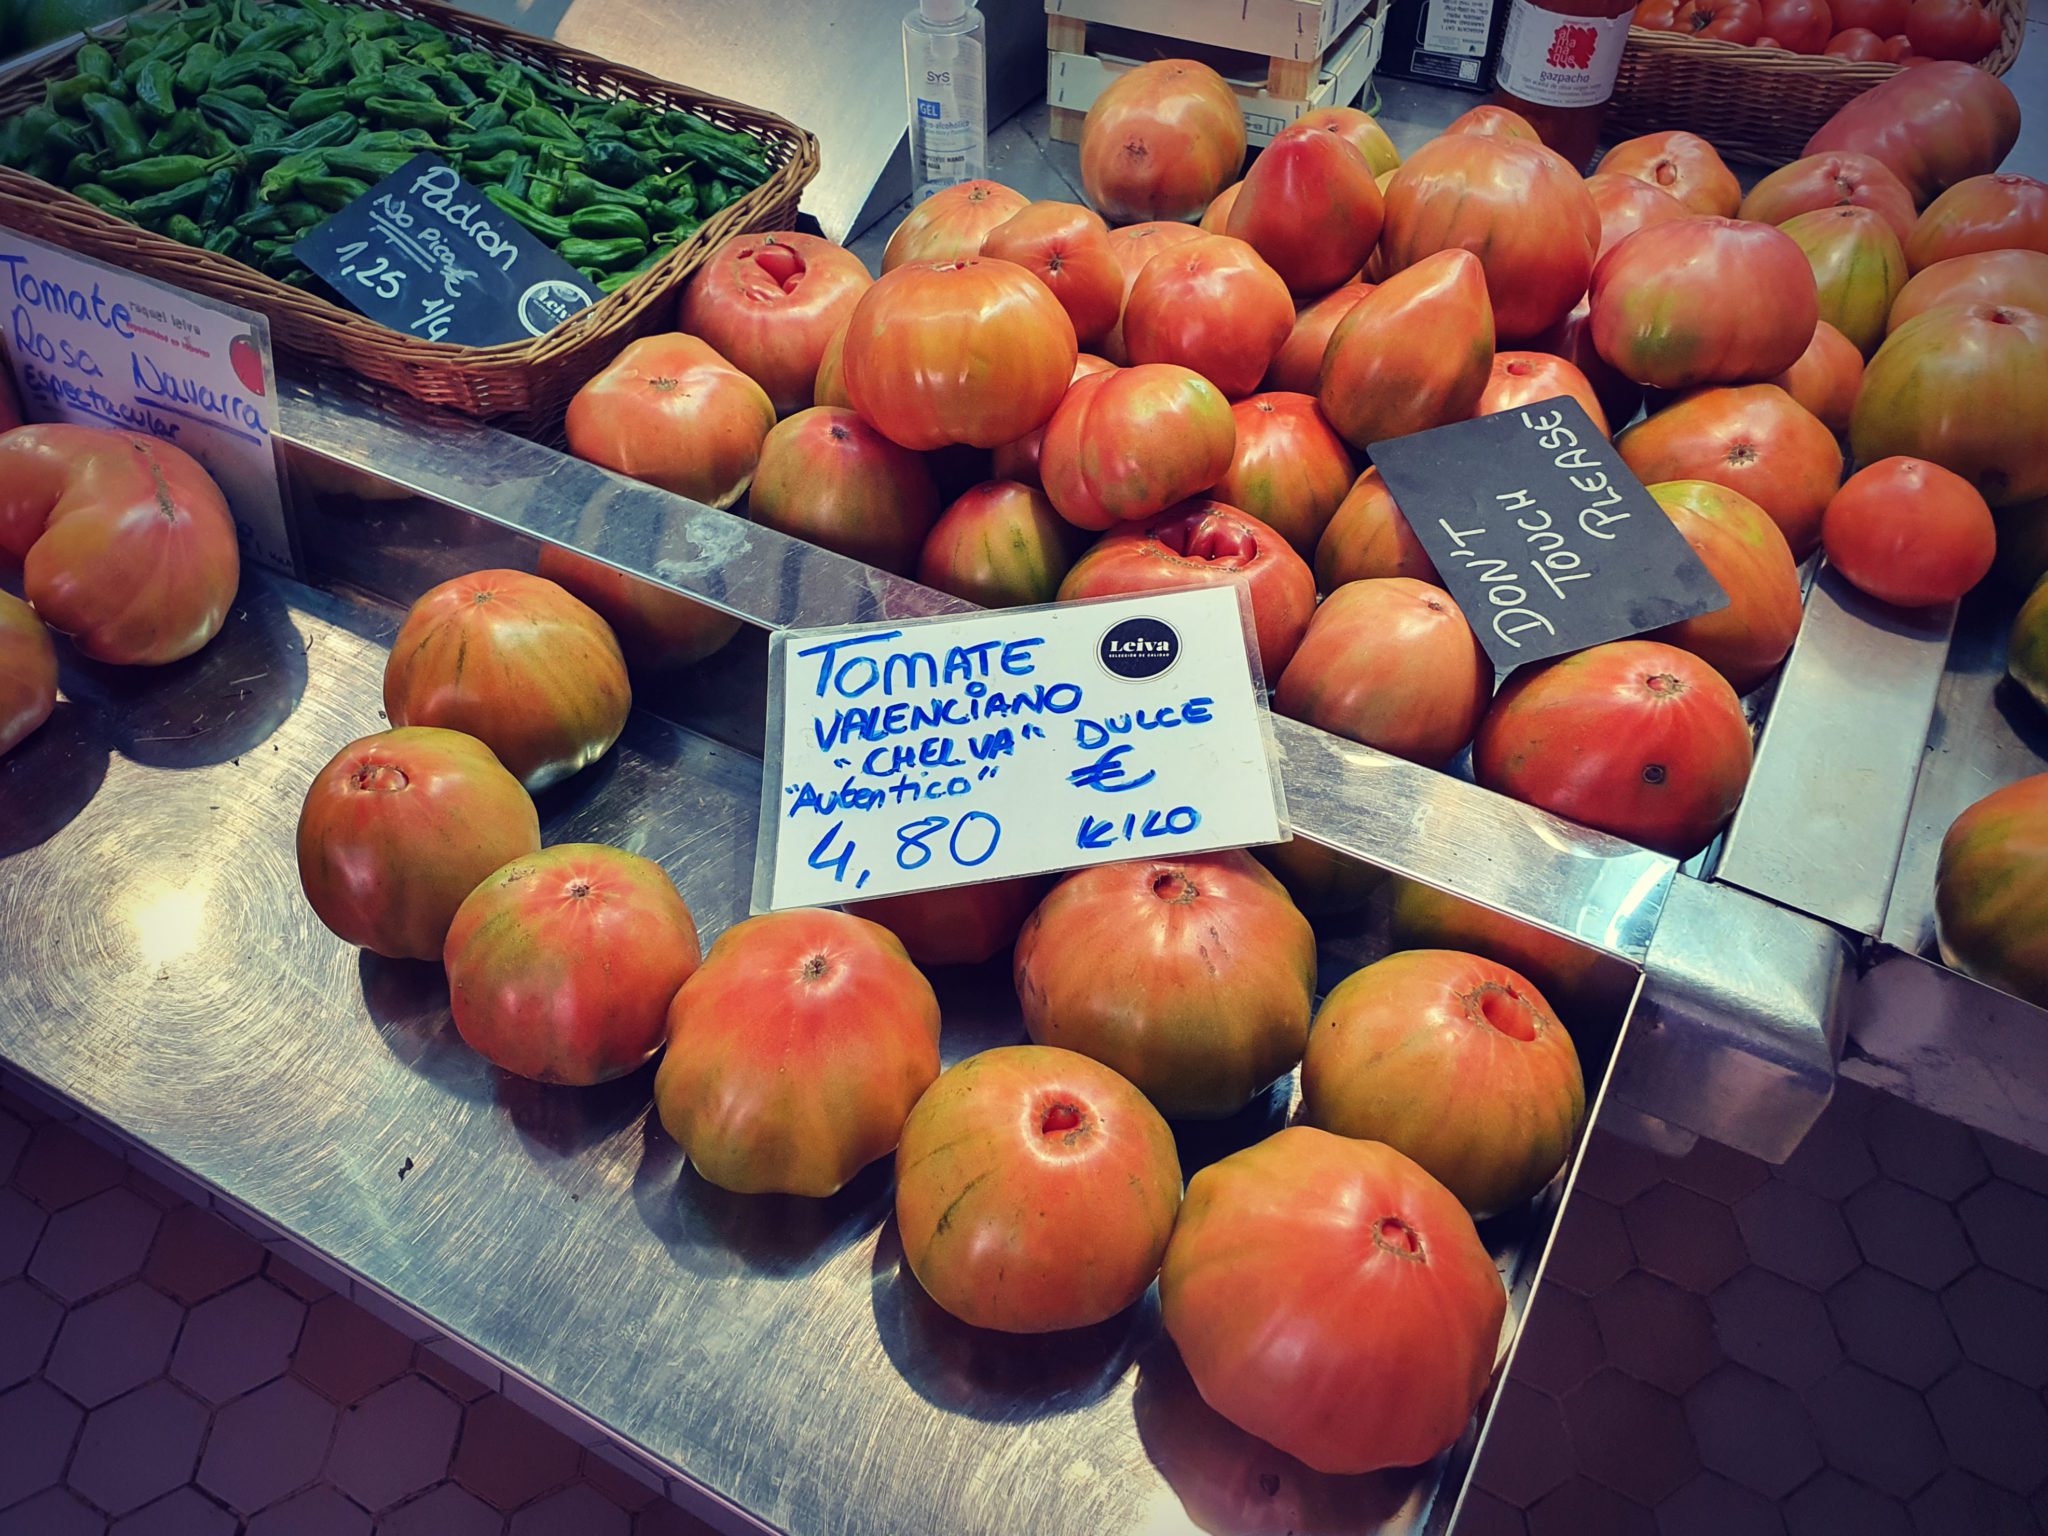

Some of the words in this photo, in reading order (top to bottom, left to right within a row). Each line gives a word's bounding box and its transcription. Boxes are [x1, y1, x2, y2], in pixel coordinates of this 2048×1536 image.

[920, 104, 939, 117] GEL
[1540, 71, 1590, 84] gazpacho
[409, 166, 518, 271] Padron
[0, 254, 135, 339] Tomate
[336, 241, 406, 298] 1,25
[11, 303, 103, 378] Rosa
[131, 351, 268, 434] Navarra
[24, 364, 180, 439] Espectacular
[1521, 410, 1631, 540] PLEASE
[1496, 489, 1591, 600] TOUCH
[1439, 518, 1555, 648] DON'T
[798, 630, 1045, 698] TOMATE
[1110, 637, 1170, 652] Leiva
[1074, 697, 1215, 750] DULCE
[1076, 806, 1202, 849] KILO
